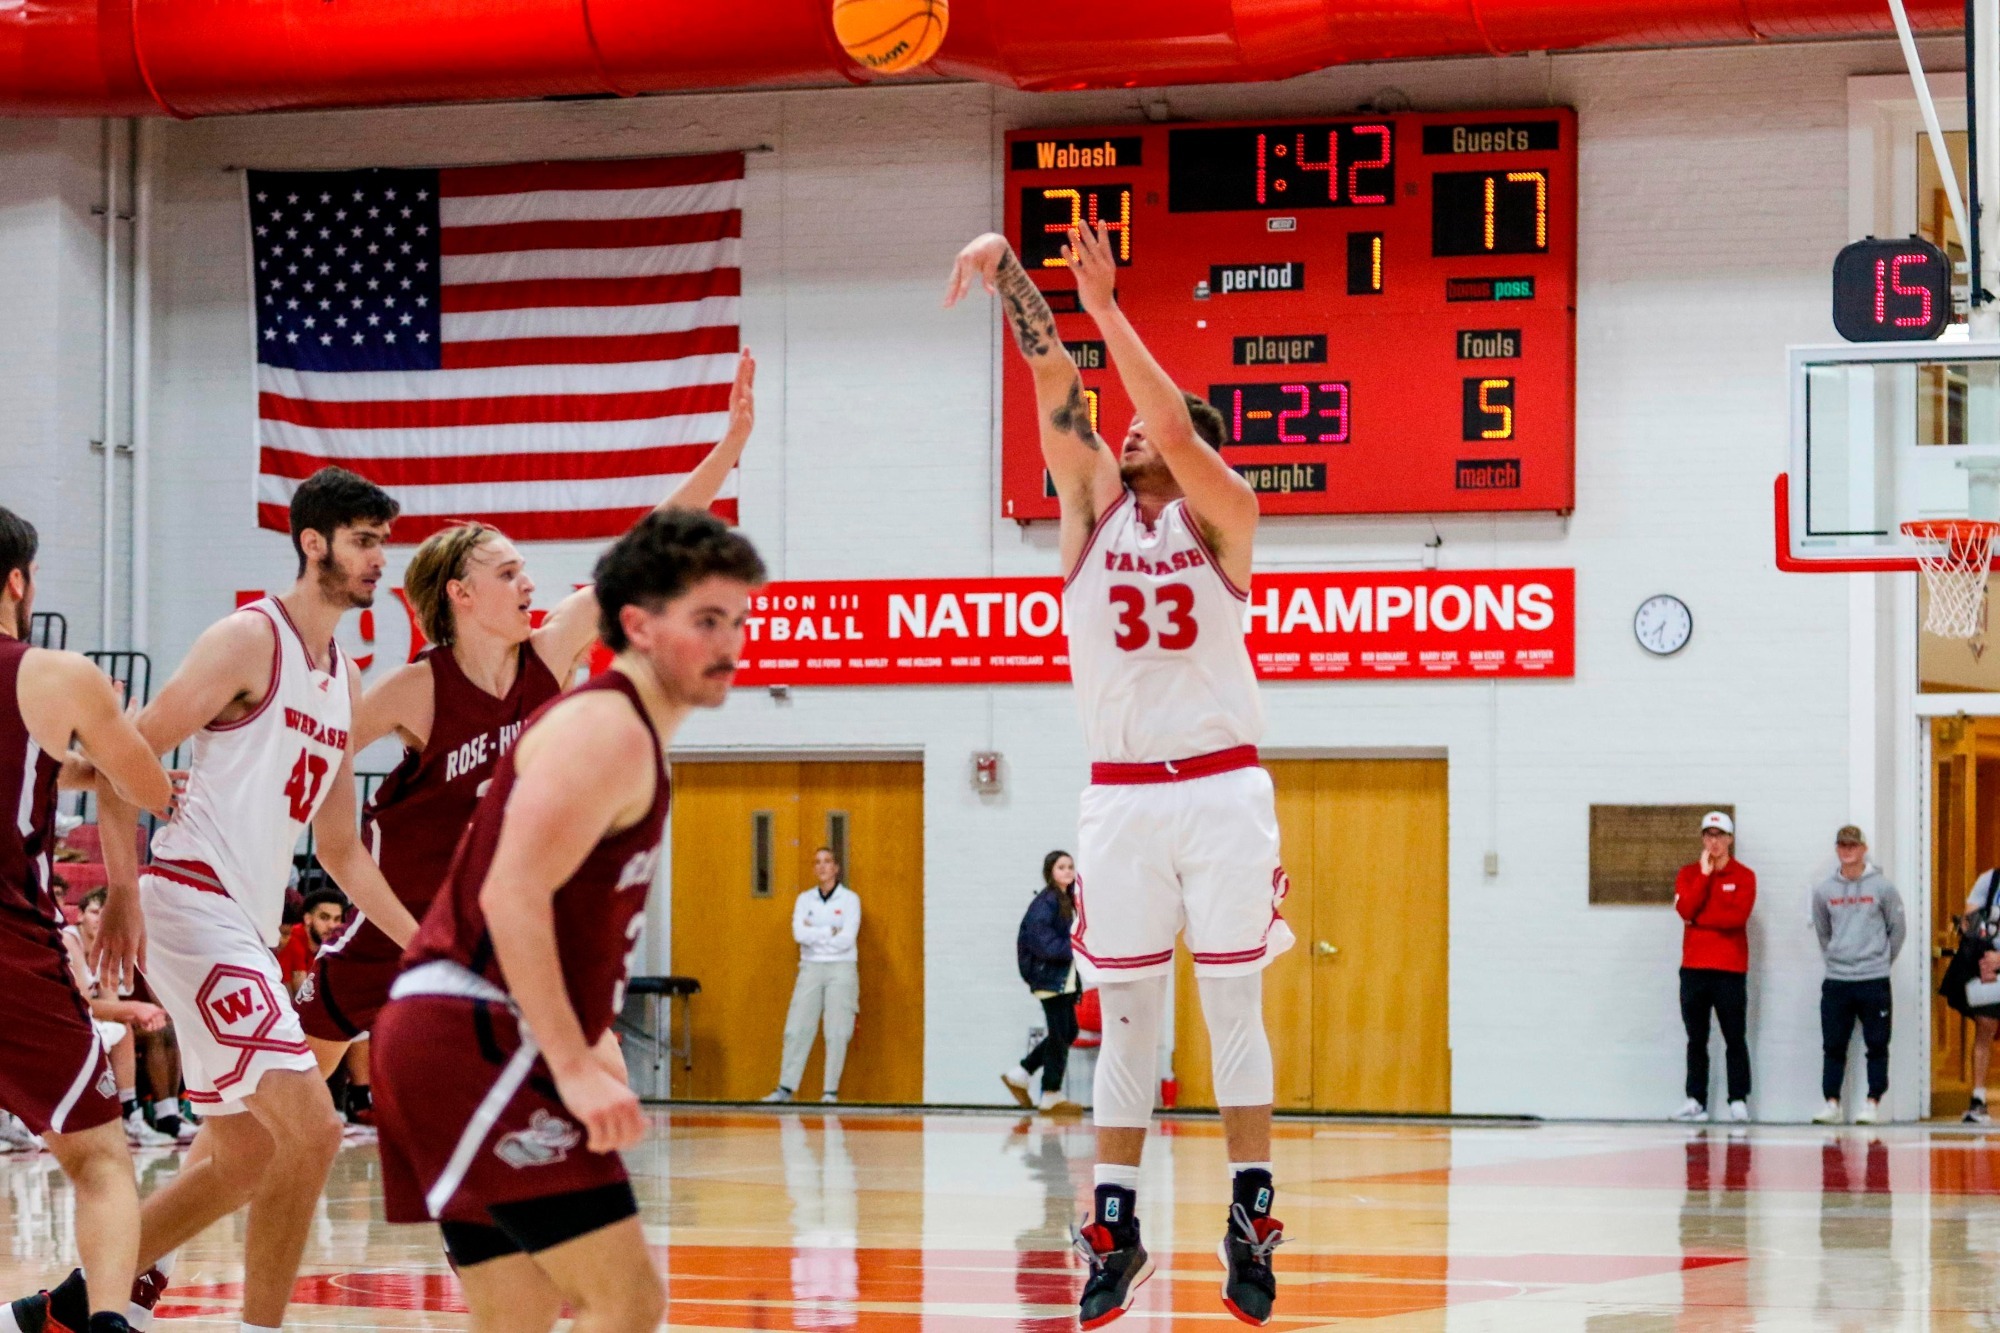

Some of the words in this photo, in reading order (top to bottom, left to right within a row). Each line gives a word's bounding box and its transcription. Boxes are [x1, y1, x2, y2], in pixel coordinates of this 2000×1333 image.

[1453, 127, 1529, 152] Guests
[1037, 142, 1116, 168] Wabash
[1256, 125, 1391, 204] 1:42
[1484, 171, 1546, 250] 17
[1043, 189, 1130, 267] 34
[1222, 262, 1292, 294] period
[1372, 237, 1381, 290] 1
[1495, 281, 1533, 301] poss.
[1873, 254, 1931, 327] 15
[1070, 343, 1100, 368] uls
[1246, 336, 1314, 365] player
[1463, 332, 1514, 358] fouls
[1479, 379, 1511, 438] 5
[1244, 464, 1314, 493] weight
[1460, 463, 1516, 488] match
[747, 595, 815, 611] ISION
[829, 595, 859, 610] III
[1109, 583, 1198, 652] 33
[1243, 584, 1554, 633] HAMPIONS
[745, 616, 864, 641] TBALL
